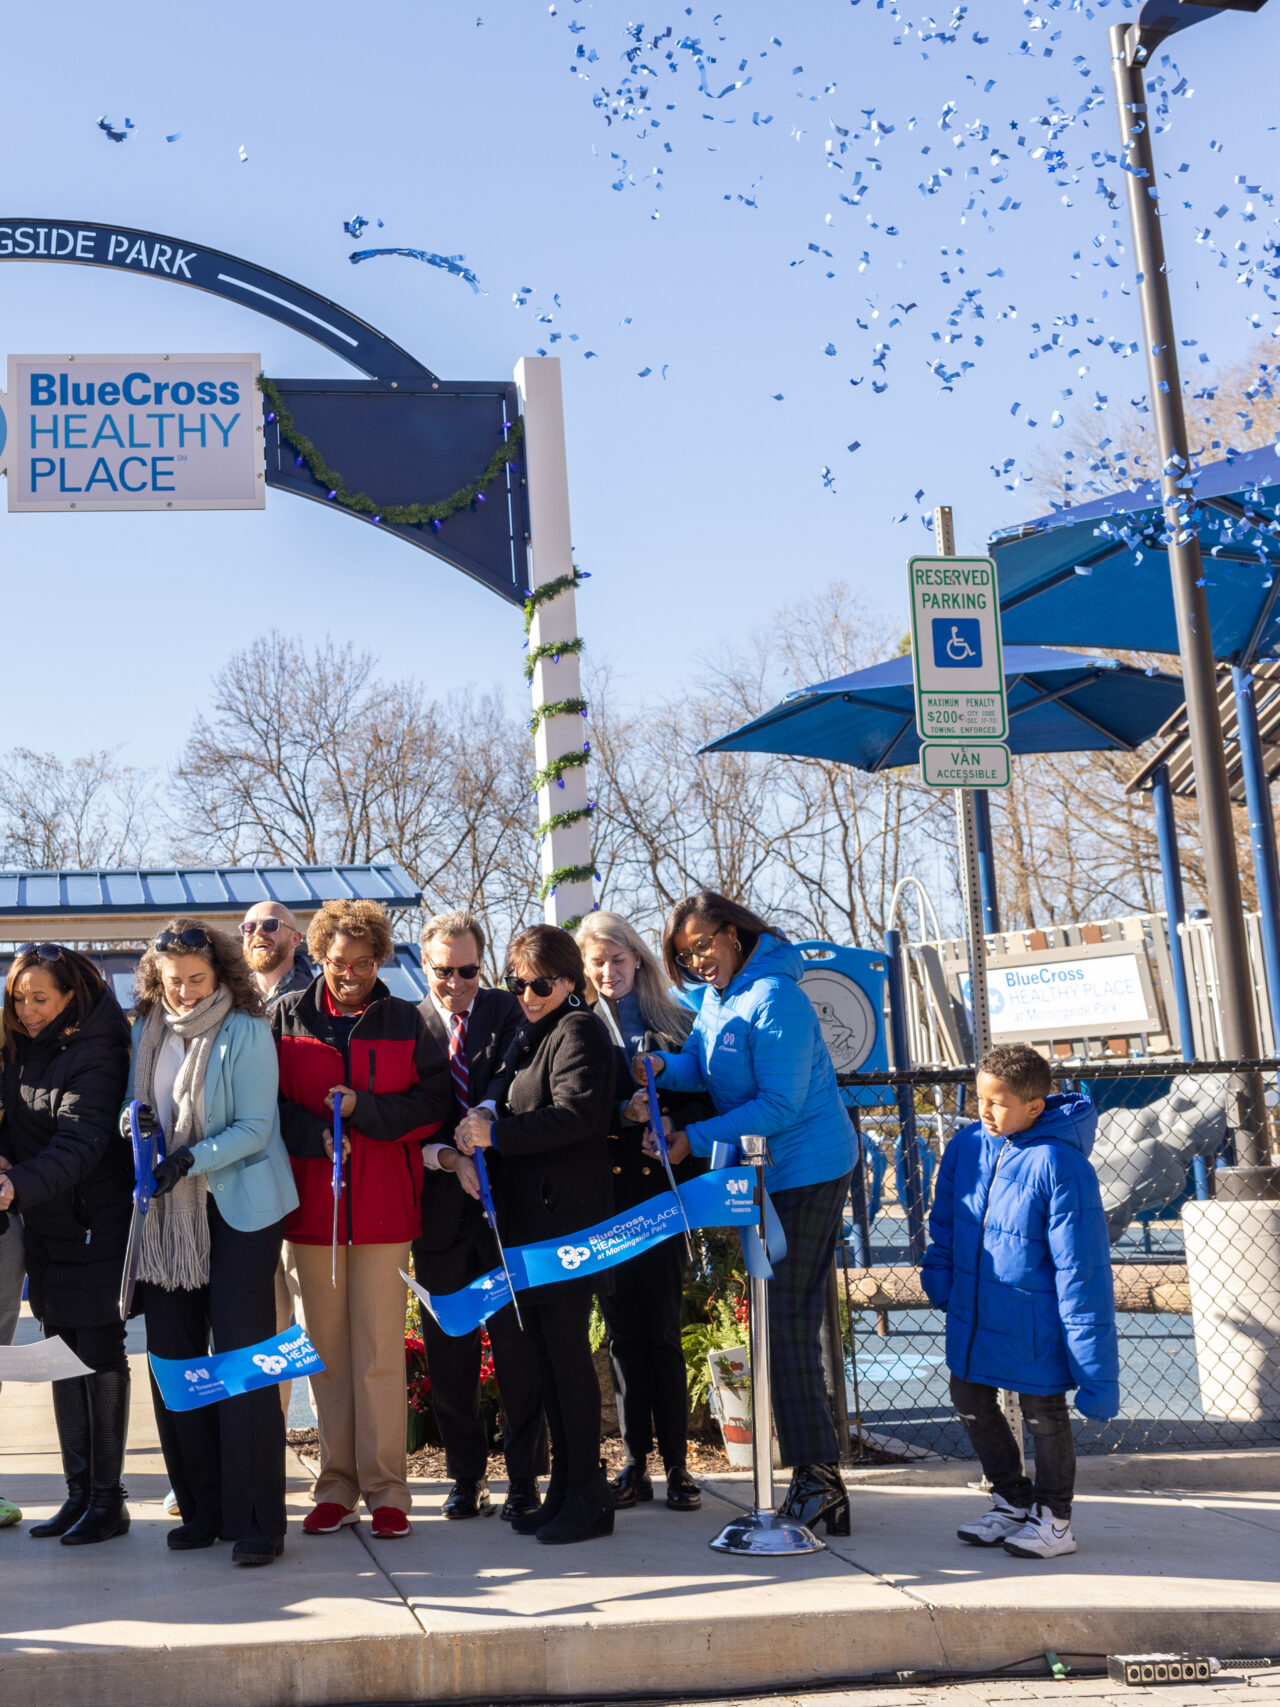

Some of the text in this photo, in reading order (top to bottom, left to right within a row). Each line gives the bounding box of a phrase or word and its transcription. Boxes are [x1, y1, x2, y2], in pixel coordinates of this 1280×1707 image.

[107, 234, 198, 279] PARK
[30, 372, 240, 406] BlueCross
[30, 413, 241, 449] HEALTHY
[30, 456, 176, 493] PLACE
[915, 569, 990, 586] RESERVED
[922, 593, 987, 610] PARKING
[927, 698, 995, 708] MAXIMUM PENALTY
[927, 710, 958, 724] $200
[950, 752, 981, 766] VAN
[936, 769, 998, 779] ACCESSIBLE
[1005, 968, 1085, 988] BlueCross
[1008, 978, 1136, 1006] HEALTHY PLACE
[1094, 1002, 1117, 1015] Park
[588, 1215, 645, 1246] BlueCross
[592, 1206, 679, 1253] HEALTHY PLACE
[597, 1222, 668, 1260] at Morningside Park
[295, 1360, 304, 1368] at
